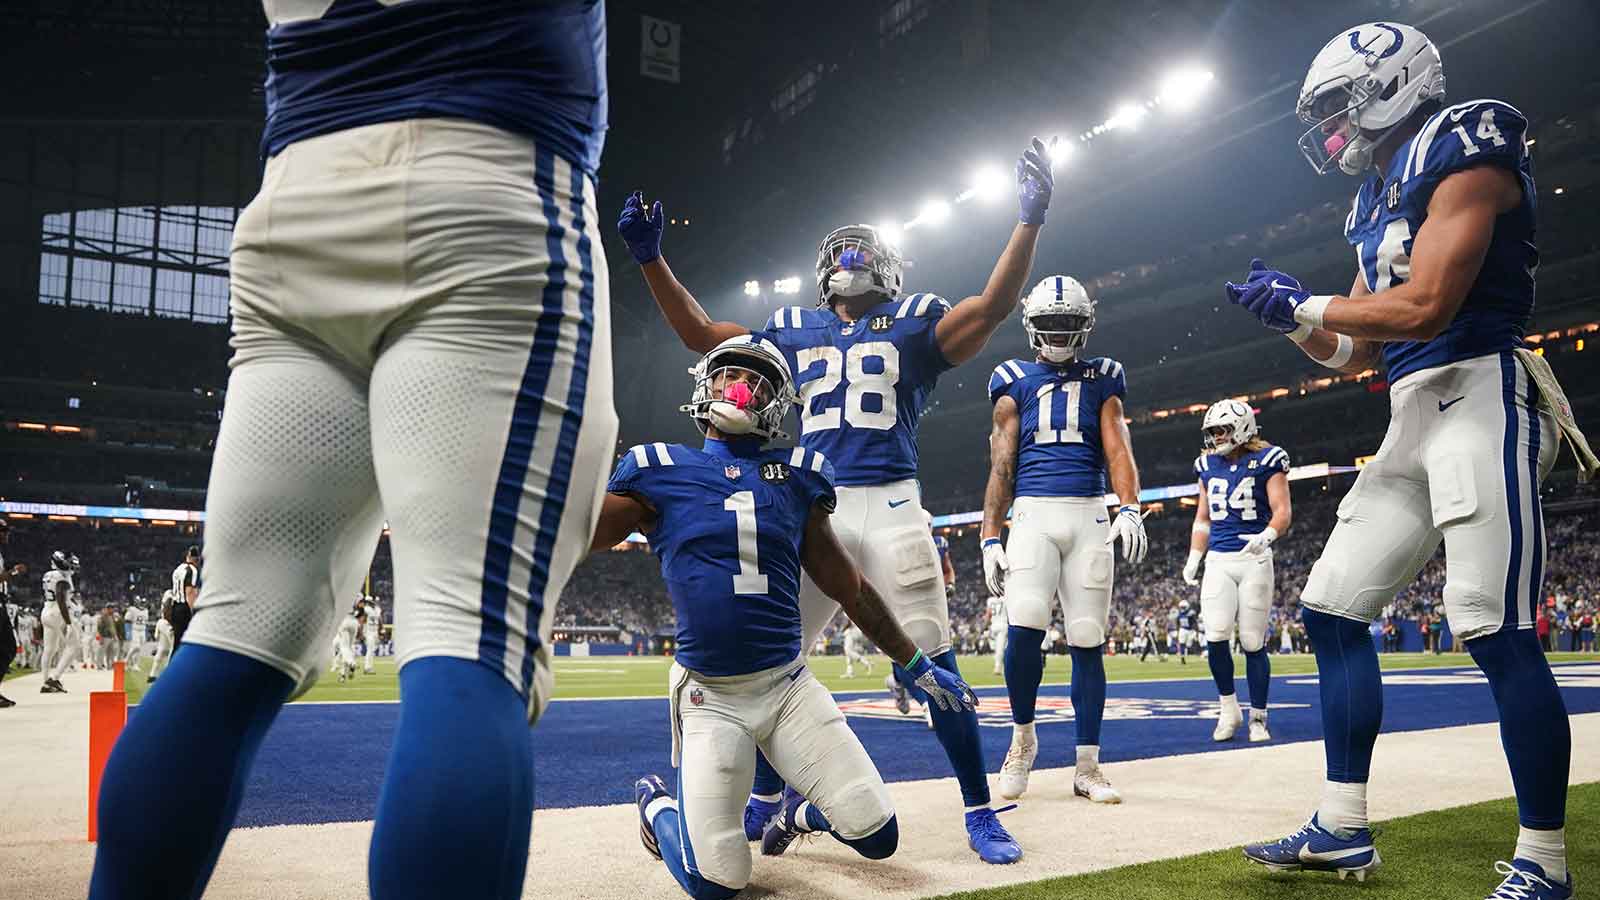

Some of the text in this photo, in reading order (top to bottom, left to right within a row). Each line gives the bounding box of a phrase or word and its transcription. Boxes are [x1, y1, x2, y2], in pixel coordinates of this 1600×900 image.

[1451, 108, 1506, 157] 14
[796, 341, 900, 435] 28
[1033, 381, 1084, 444] 11
[1207, 477, 1257, 520] 84
[724, 491, 768, 594] 1
